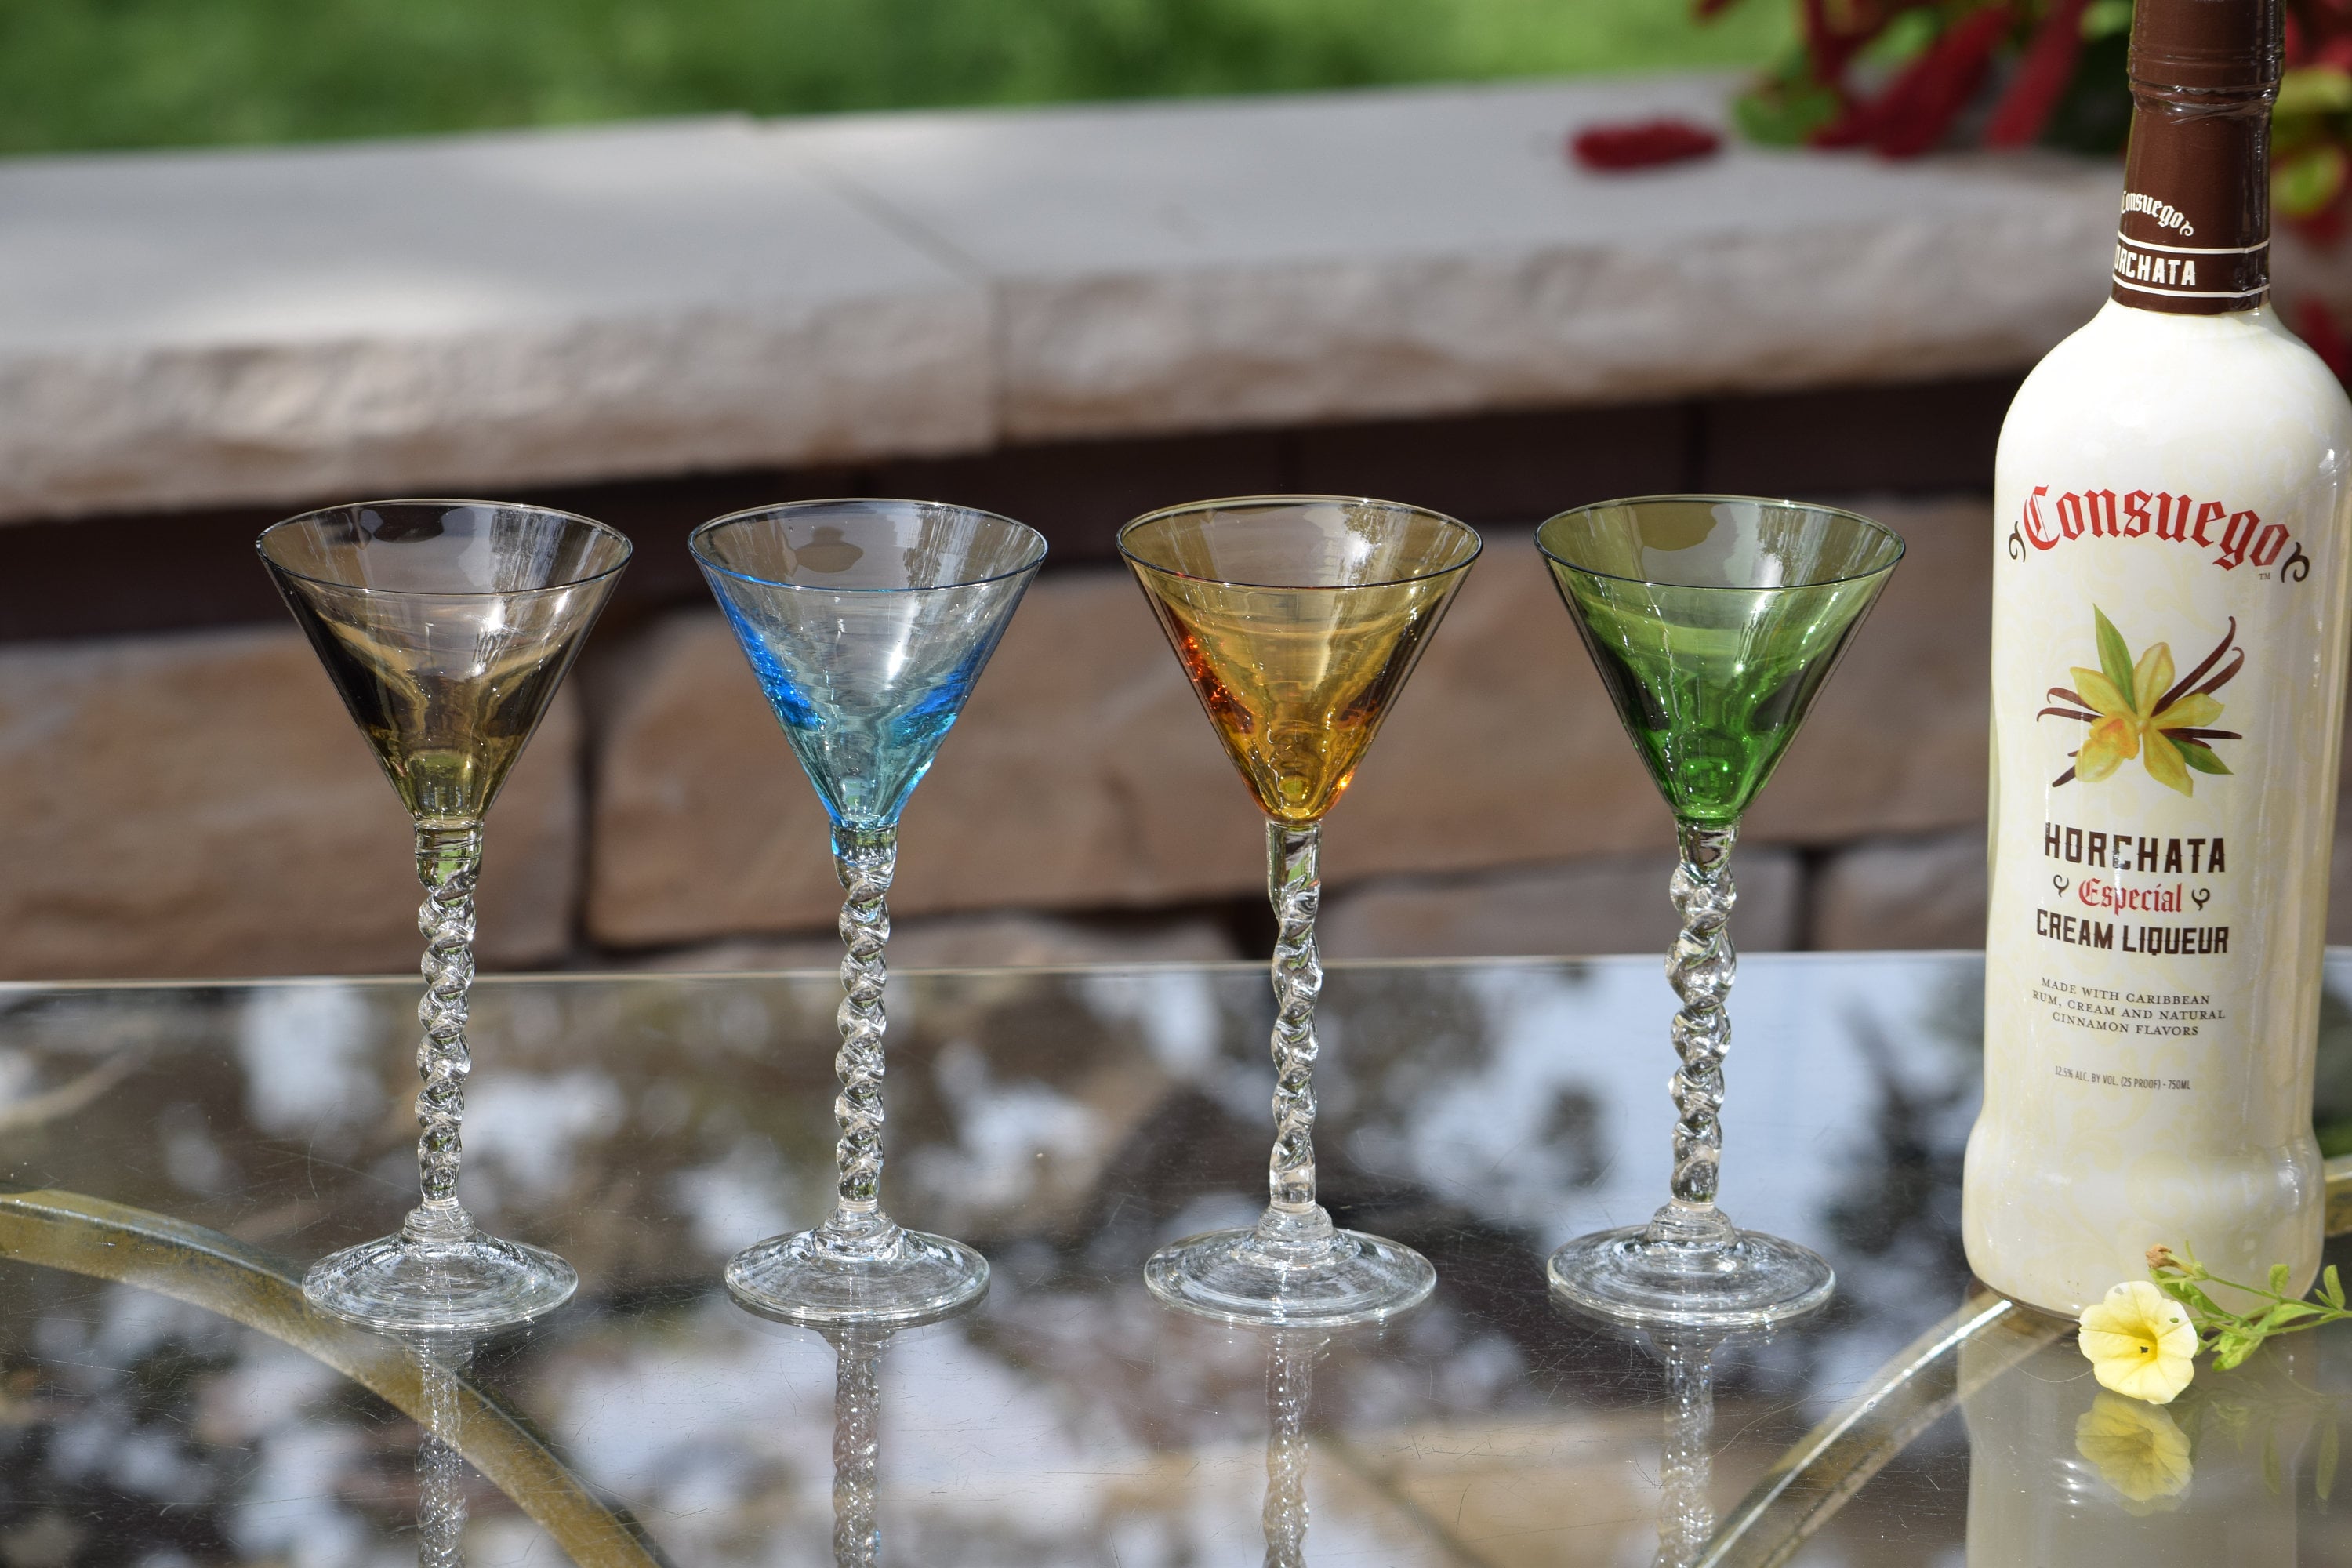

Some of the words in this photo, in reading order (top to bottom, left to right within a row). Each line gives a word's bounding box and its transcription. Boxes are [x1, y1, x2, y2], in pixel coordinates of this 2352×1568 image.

[2114, 243, 2196, 286] ORCHATA
[2024, 485, 2290, 571] Consuego
[2045, 822, 2225, 873] HORCHATA
[2037, 908, 2114, 950] CREAM
[2122, 925, 2230, 956] LIQUEUR
[2032, 989, 2062, 1008] RUM,
[2067, 1000, 2115, 1016] CREAM
[2121, 1009, 2153, 1019] AND
[2159, 1009, 2226, 1020] NATURAL
[2042, 977, 2076, 995] MADE
[2081, 986, 2119, 1001] WITH
[2125, 993, 2210, 1005] CARIBBEAN
[2053, 1011, 2129, 1033] CINNAMON
[2136, 1025, 2199, 1036] FLAVORS
[2075, 1070, 2089, 1082] ALC.
[2092, 1073, 2100, 1083] BY
[2103, 1075, 2118, 1086] VOL.
[2121, 1076, 2132, 1087] (25
[2134, 1078, 2161, 1091] PROOF)
[2168, 1080, 2191, 1090] 750ML
